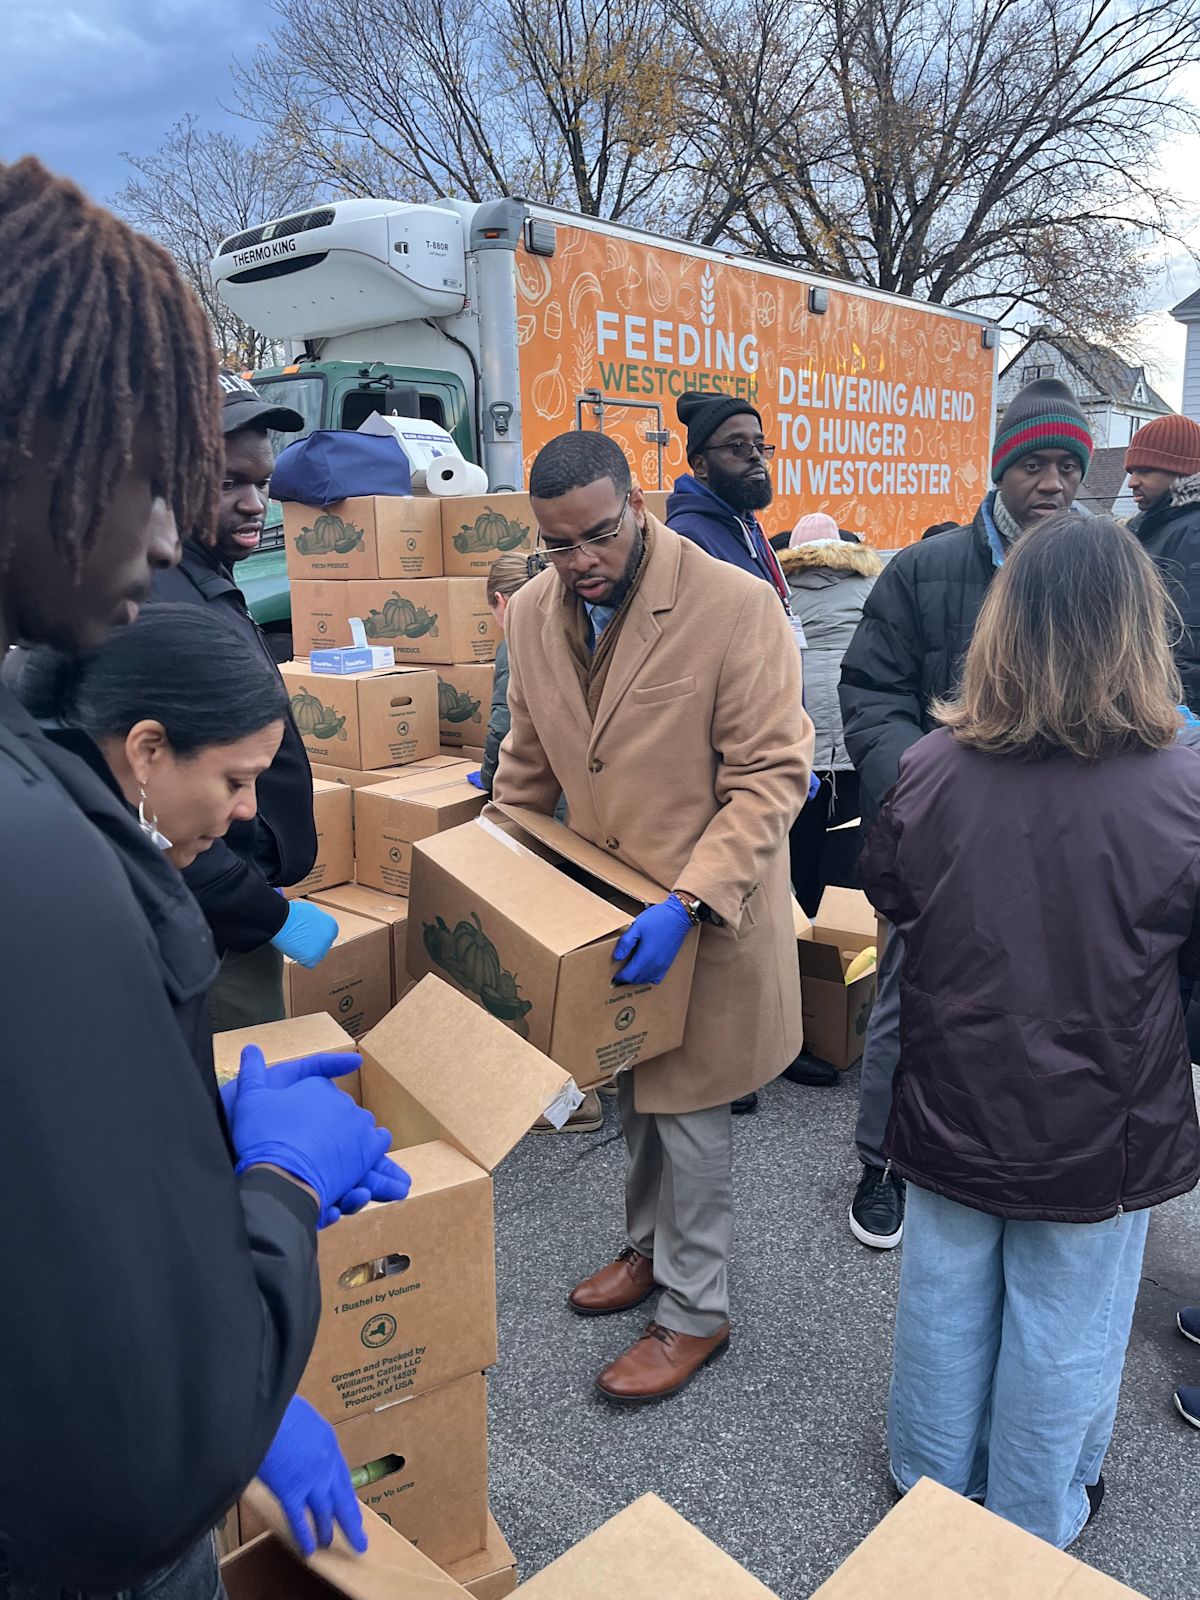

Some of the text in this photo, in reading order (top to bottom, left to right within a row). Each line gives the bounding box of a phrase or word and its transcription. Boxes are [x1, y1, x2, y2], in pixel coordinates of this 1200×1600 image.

[232, 238, 297, 267] THERMO KING
[596, 310, 759, 374] FEEDING
[598, 360, 759, 404] WESTCHESTER
[778, 366, 975, 423] DELIVERING AN END
[777, 412, 908, 457] TO HUNGER
[777, 458, 952, 496] IN WESTCHESTER
[341, 1295, 373, 1313] Bushel
[375, 1293, 387, 1302] by
[388, 1282, 421, 1298] Volume
[331, 1346, 426, 1383] Grown and Packed by
[336, 1356, 421, 1391] Williams Cattle LLC
[341, 1367, 417, 1400] Marion, NY 14505
[345, 1379, 414, 1409] Produce of USA
